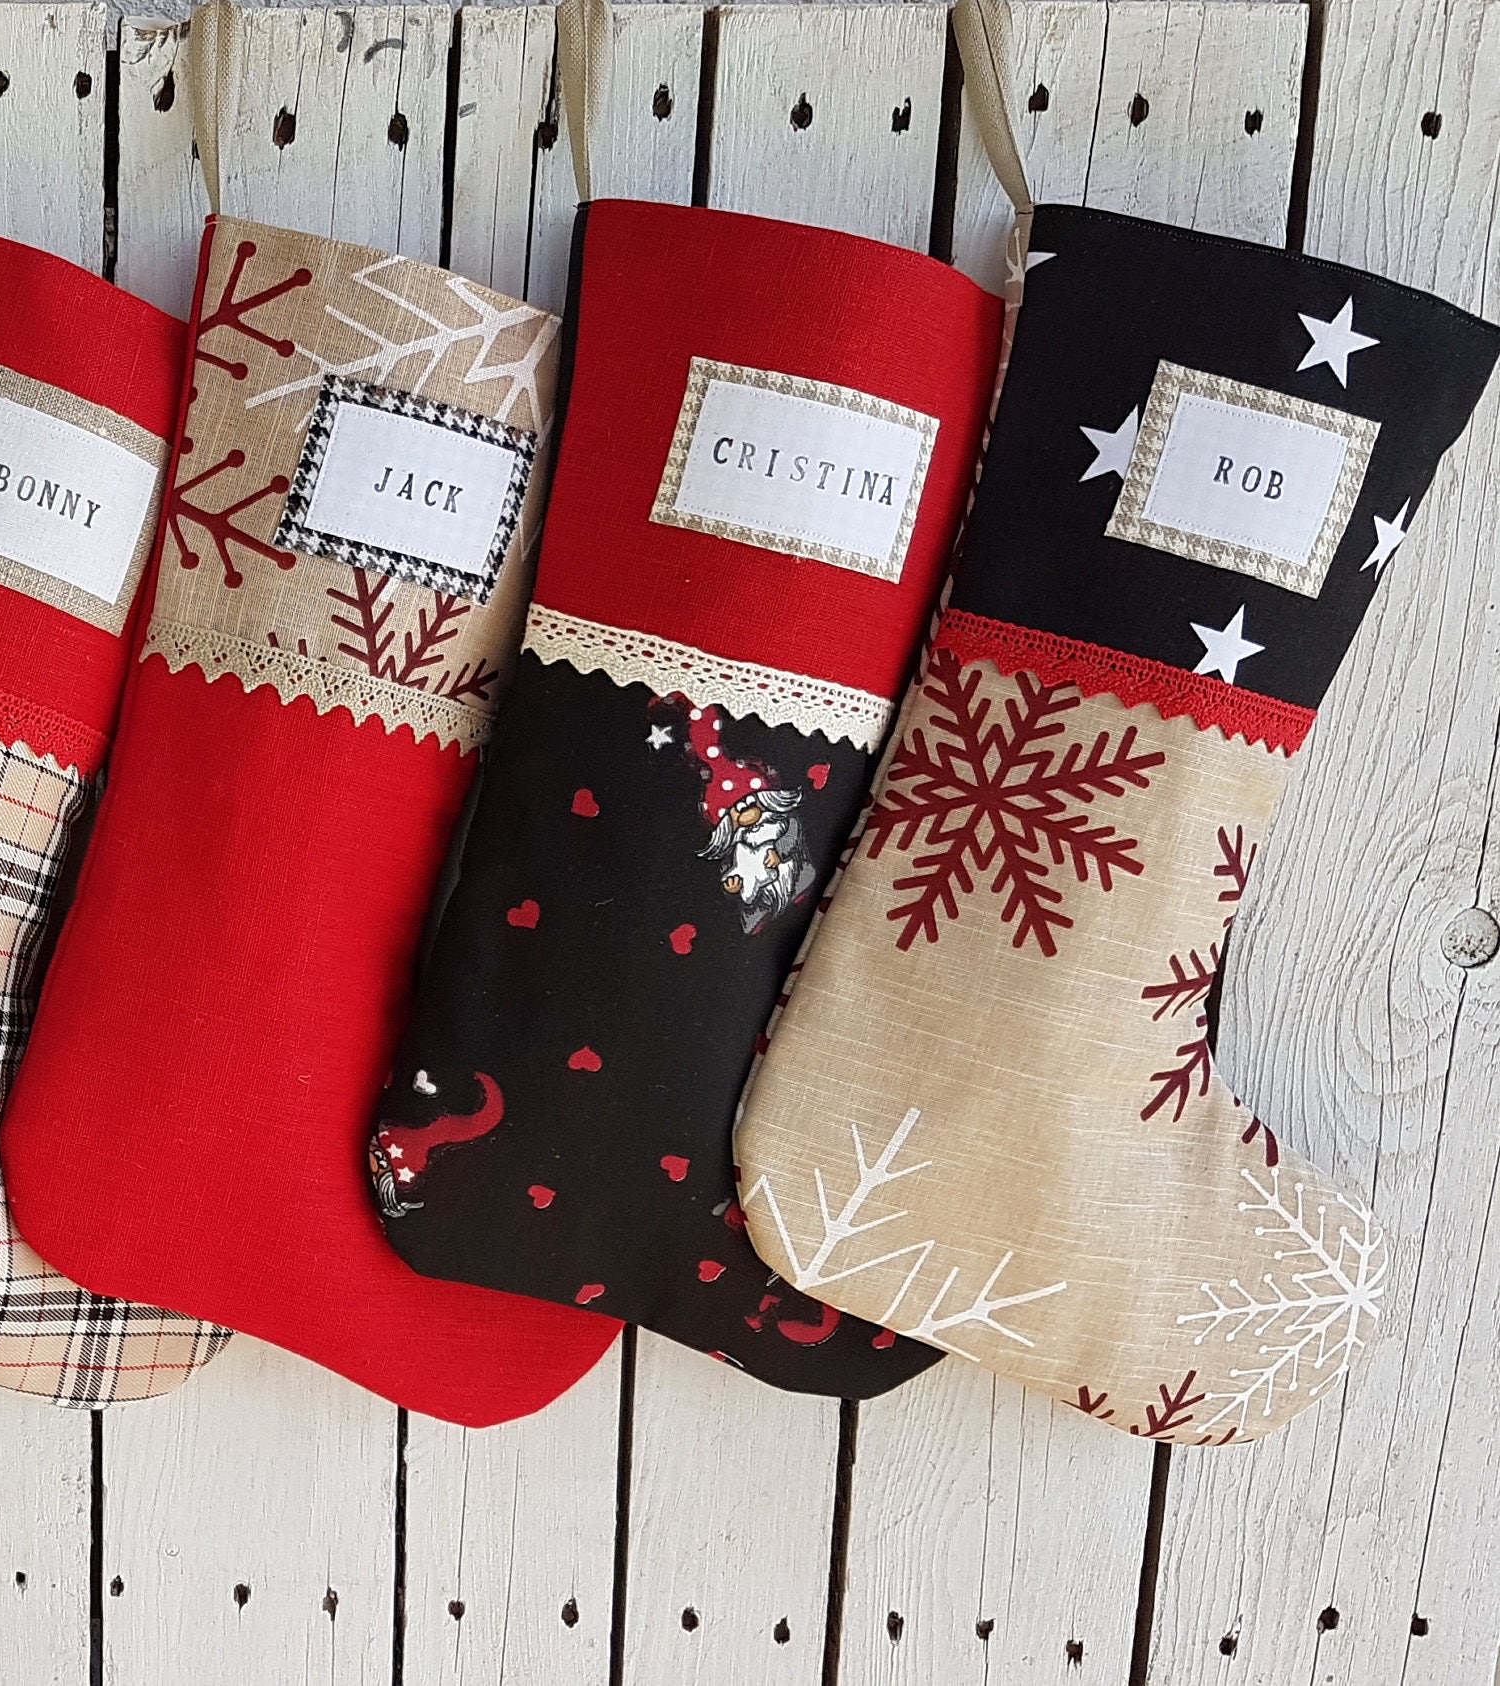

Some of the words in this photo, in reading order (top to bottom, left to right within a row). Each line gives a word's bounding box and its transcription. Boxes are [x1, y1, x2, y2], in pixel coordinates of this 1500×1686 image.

[374, 467, 463, 513] JACK
[713, 437, 896, 505] CRISTINA
[1213, 455, 1284, 499] ROB
